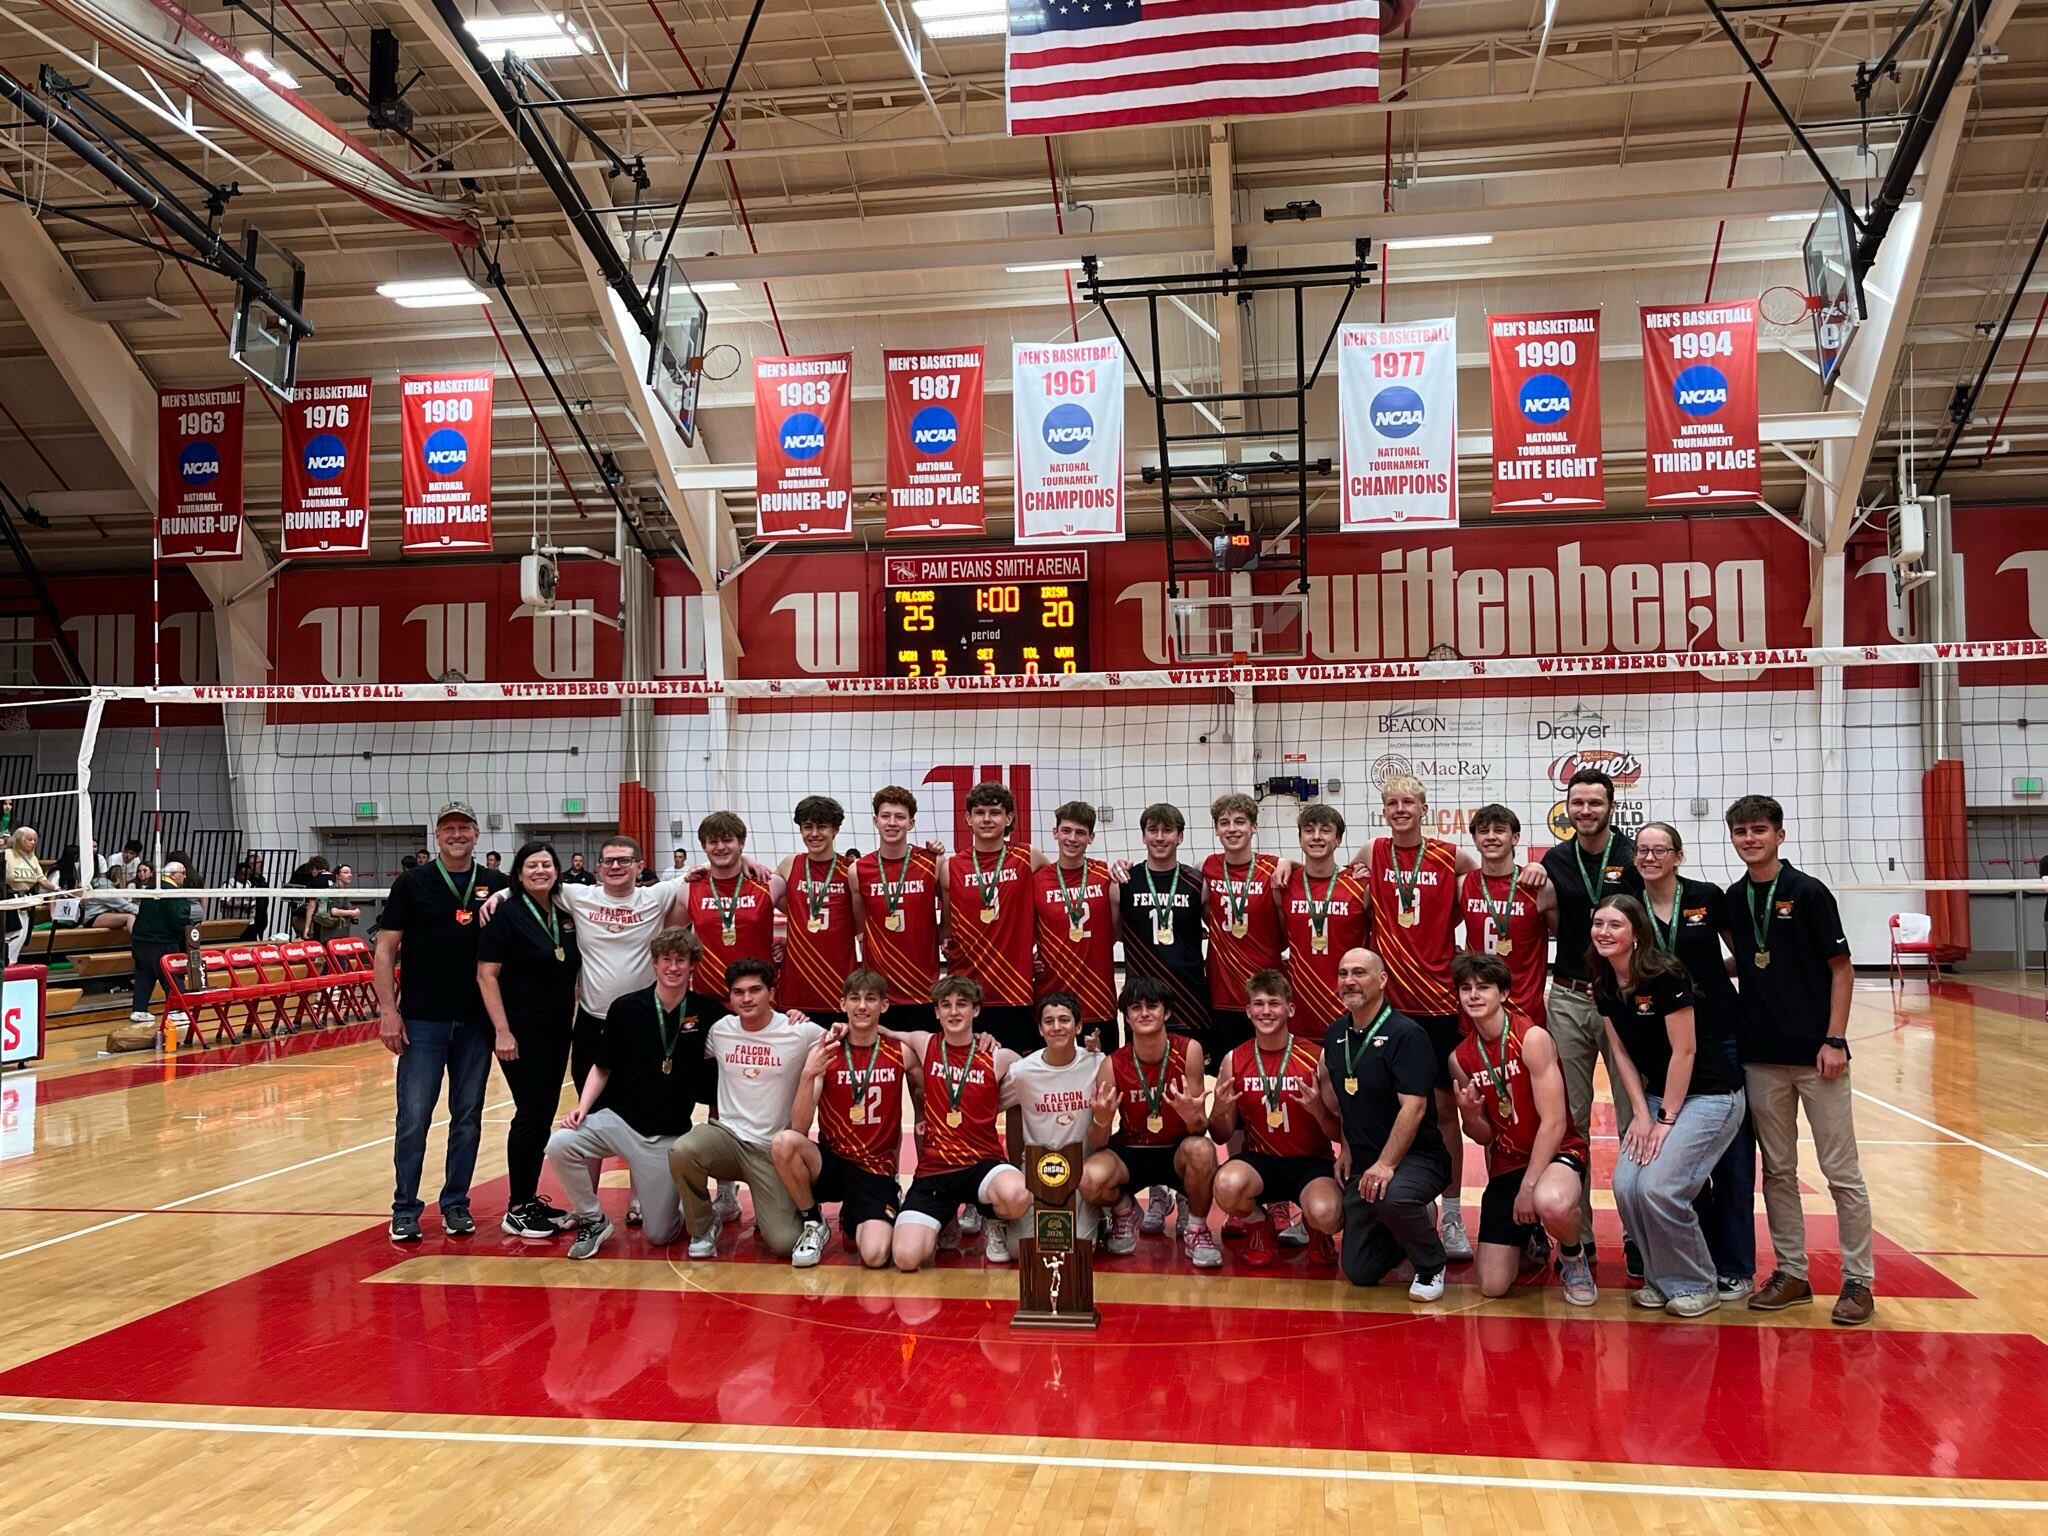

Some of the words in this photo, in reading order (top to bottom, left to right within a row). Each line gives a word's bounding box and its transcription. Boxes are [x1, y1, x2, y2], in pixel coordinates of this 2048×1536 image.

[1646, 313, 1680, 328] MEN'S
[1682, 309, 1752, 326] BASKETBALL
[1493, 321, 1528, 336] MEN'S
[1530, 318, 1595, 335] BASKETBALL
[1344, 332, 1377, 346] MEN'S
[1380, 327, 1450, 345] BASKETBALL
[1669, 331, 1732, 359] 1994
[1018, 350, 1050, 364] MEN'S
[1052, 346, 1118, 363] BASKETBALL
[1514, 340, 1576, 368] 1990
[758, 364, 786, 378] MEN'S
[788, 360, 847, 376] BASKETBALL
[889, 356, 918, 371] MEN'S
[920, 354, 980, 370] BASKETBALL
[1370, 351, 1425, 378] 1977
[404, 381, 430, 396] MEN'S
[432, 378, 490, 394] BASKETBALL
[909, 374, 960, 400] 1987
[1042, 370, 1096, 396] 1961
[162, 394, 187, 408] MEN'S
[188, 391, 240, 406] BASKETBALL
[314, 385, 368, 400] BASKETBALL
[777, 381, 831, 406] 1983
[1679, 388, 1726, 404] NCAA
[422, 399, 473, 424] 1980
[1524, 398, 1570, 412] NCAA
[178, 412, 224, 435] 1963
[304, 404, 349, 428] 1976
[1375, 411, 1423, 426] NCAA
[915, 429, 956, 443] NCAA
[1048, 428, 1094, 442] NCAA
[1680, 424, 1724, 435] NATIONAL
[784, 434, 824, 448] NCAA
[1526, 432, 1567, 443] NATIONAL
[1672, 436, 1733, 448] TOURNAMENT
[428, 450, 467, 464] NCAA
[1378, 446, 1421, 457] NATIONAL
[1518, 444, 1576, 456] TOURNAMENT
[183, 462, 219, 474] NCAA
[308, 456, 345, 470] NCAA
[916, 462, 953, 472] NATIONAL
[1050, 462, 1090, 473] NATIONAL
[1369, 459, 1430, 471] TOURNAMENT
[1499, 459, 1544, 480] ELITE
[1548, 456, 1597, 479] EIGHT
[1652, 452, 1702, 473] THIRD
[1704, 449, 1756, 470] PLACE
[786, 466, 822, 477] NATIONAL
[908, 472, 961, 484] TOURNAMENT
[428, 482, 464, 491] NATIONAL
[778, 478, 830, 489] TOURNAMENT
[1042, 474, 1098, 486] TOURNAMENT
[1351, 474, 1448, 496] CHAMPIONS
[184, 492, 216, 502] NATIONAL
[308, 486, 342, 496] NATIONAL
[422, 492, 470, 502] TOURNAMENT
[892, 488, 934, 506] THIRD
[937, 486, 980, 504] PLACE
[302, 497, 349, 508] TOURNAMENT
[762, 491, 847, 512] RUNNER-UP
[1025, 488, 1114, 512] CHAMPIONS
[178, 503, 223, 513] TOURNAMENT
[405, 506, 444, 524] THIRD
[448, 505, 488, 523] PLACE
[162, 516, 238, 535] RUNNER-UP
[286, 510, 364, 530] RUNNER-UP
[922, 562, 948, 579] PAM
[952, 560, 992, 578] EVANS
[996, 558, 1035, 577] SMITH
[1036, 558, 1081, 576] ARENA
[896, 590, 935, 602] FALCONS
[976, 586, 1020, 612] 1:00
[1041, 586, 1068, 598] IRISH
[903, 606, 934, 631] 25
[1042, 601, 1074, 628] 20
[972, 629, 1000, 641] period
[898, 650, 918, 662] WON
[977, 648, 994, 660] SET
[1054, 646, 1074, 658] WON
[1536, 655, 1668, 672] WITTENBERG
[1674, 650, 1808, 667] VOLLEYBALL
[1168, 668, 1289, 684] WITTENBERG
[1296, 664, 1420, 680] VOLLEYBALL
[500, 682, 608, 696] WITTENBERG
[614, 681, 724, 695] VOLLEYBALL
[826, 678, 939, 692] WITTENBERG
[946, 674, 1060, 690] VOLLEYBALL
[194, 686, 295, 699] WITTENBERG
[301, 685, 403, 698] VOLLEYBALL
[1378, 715, 1446, 732] BEACON
[1536, 720, 1610, 744] Drayer
[1420, 760, 1492, 780] MacRay
[588, 912, 644, 924] VOLLEYBALL
[600, 907, 634, 916] FALCON
[734, 1044, 770, 1056] FALCON
[725, 1054, 782, 1066] VOLLEYBALL
[1044, 1091, 1082, 1102] FALCON
[1044, 1166, 1064, 1174] OHSAA
